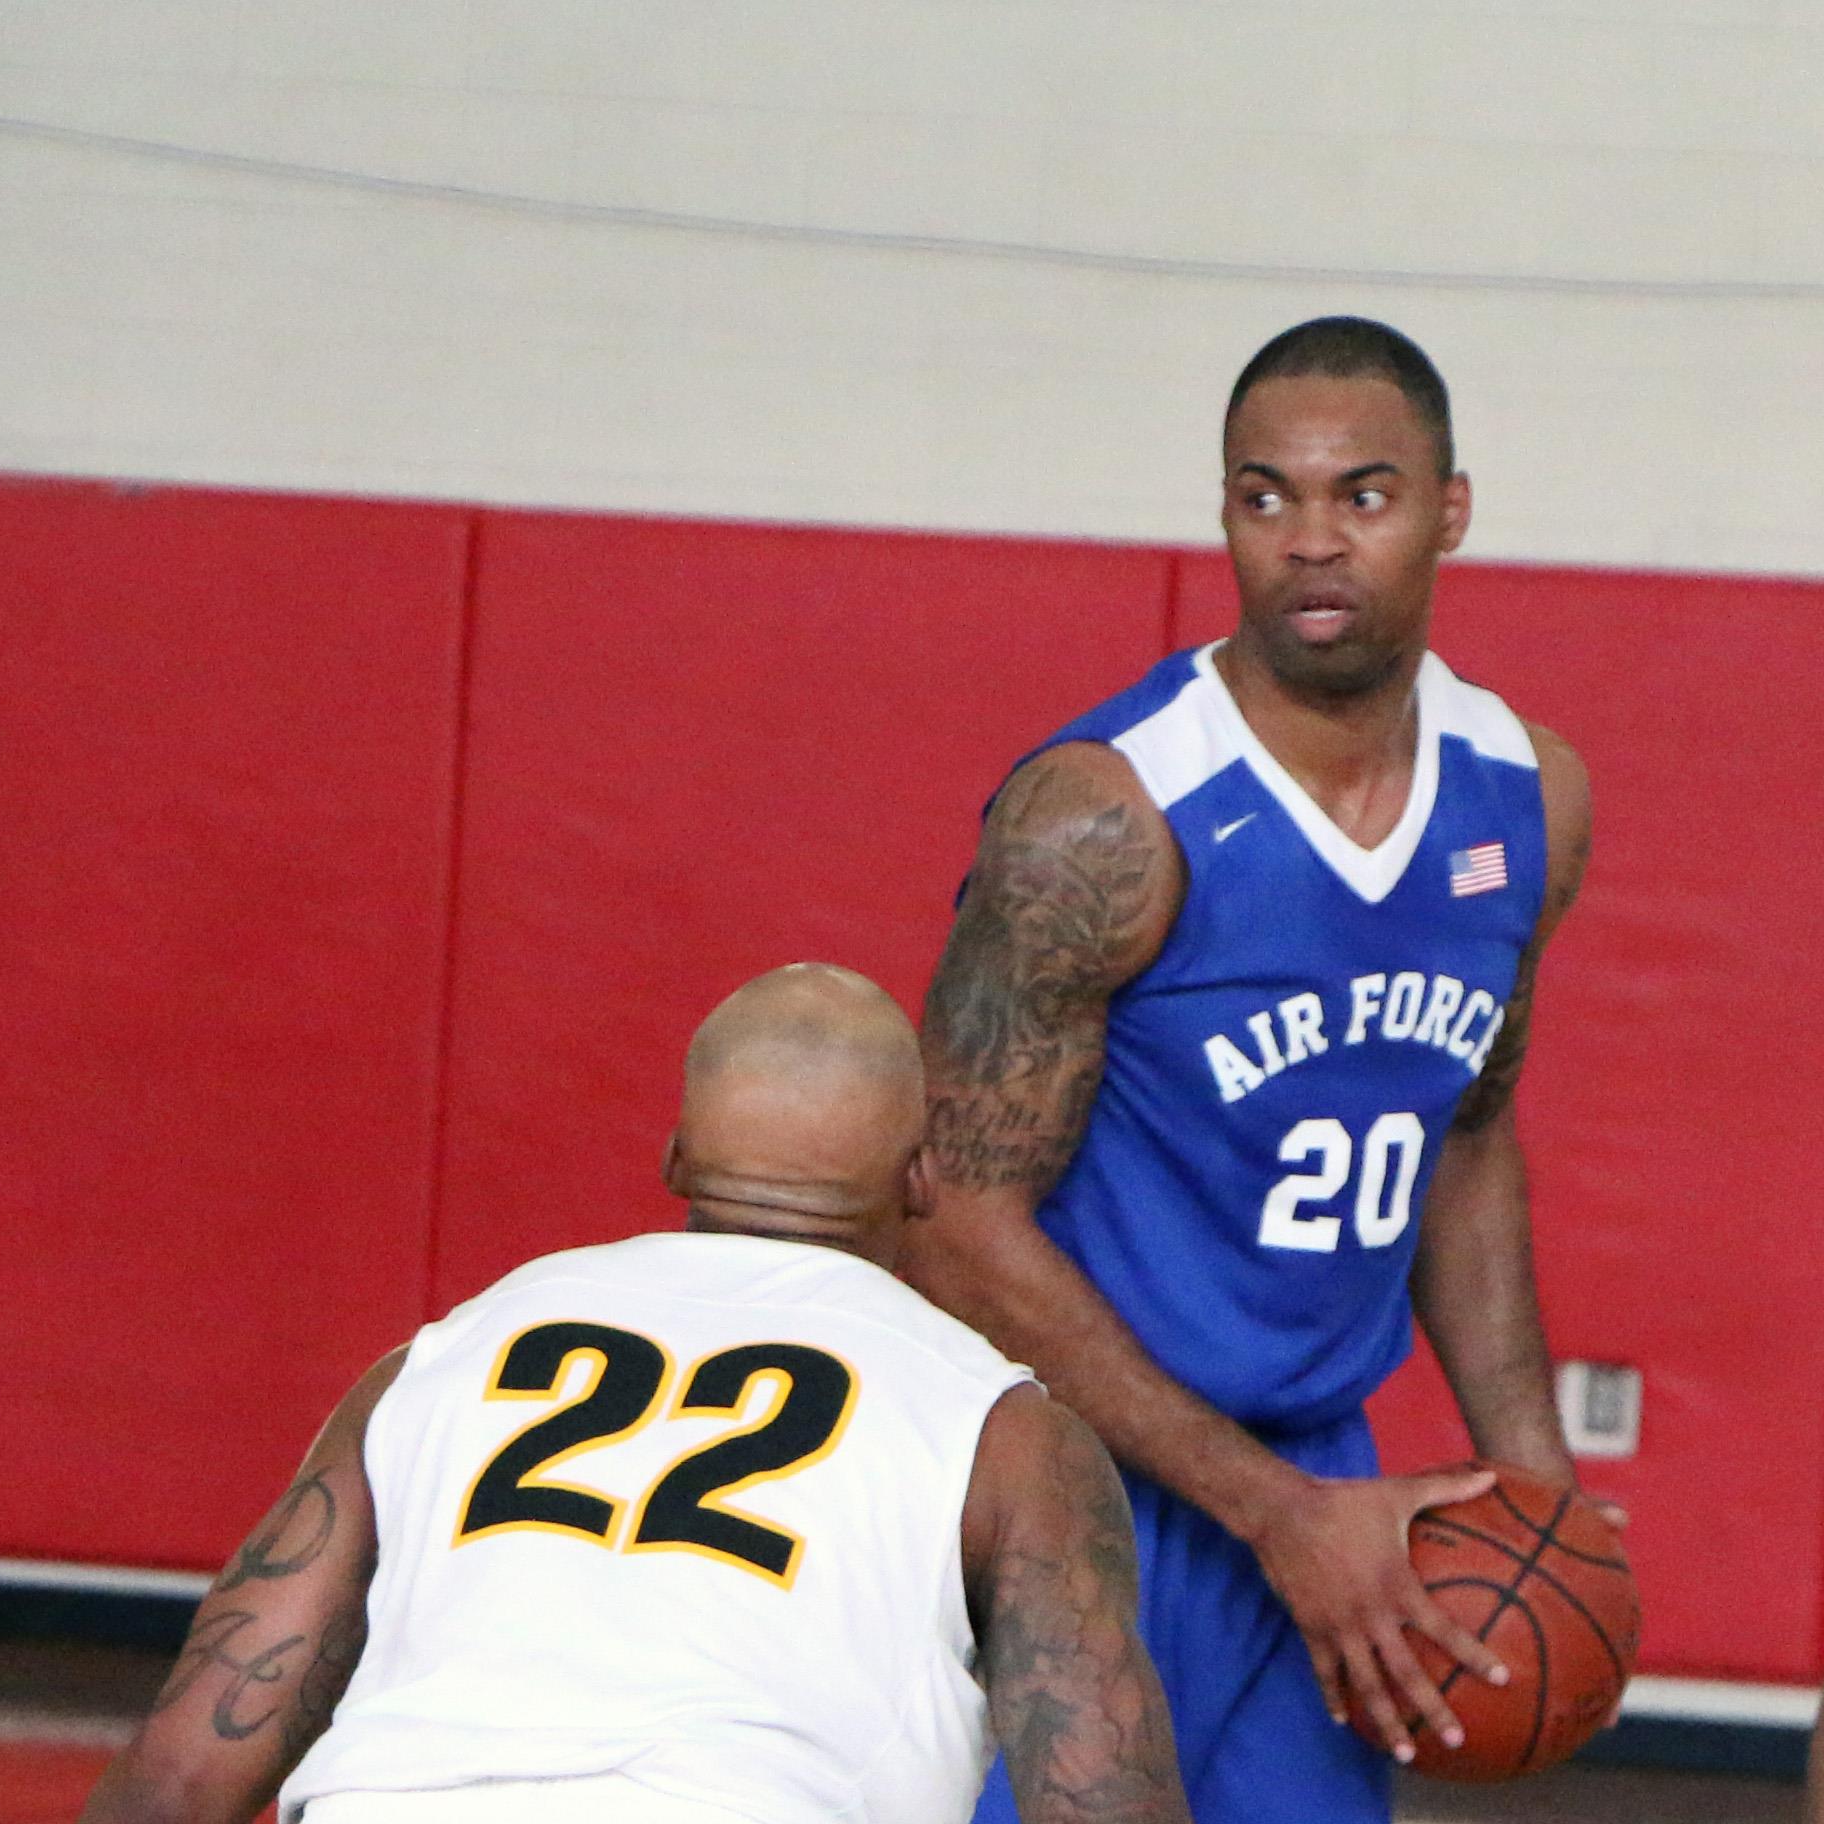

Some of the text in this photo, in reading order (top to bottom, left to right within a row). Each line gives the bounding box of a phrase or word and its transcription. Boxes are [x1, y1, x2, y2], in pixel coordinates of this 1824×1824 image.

[1203, 991, 1329, 1104] AIR
[1257, 1112, 1425, 1252] 20
[450, 1317, 862, 1592] 22
